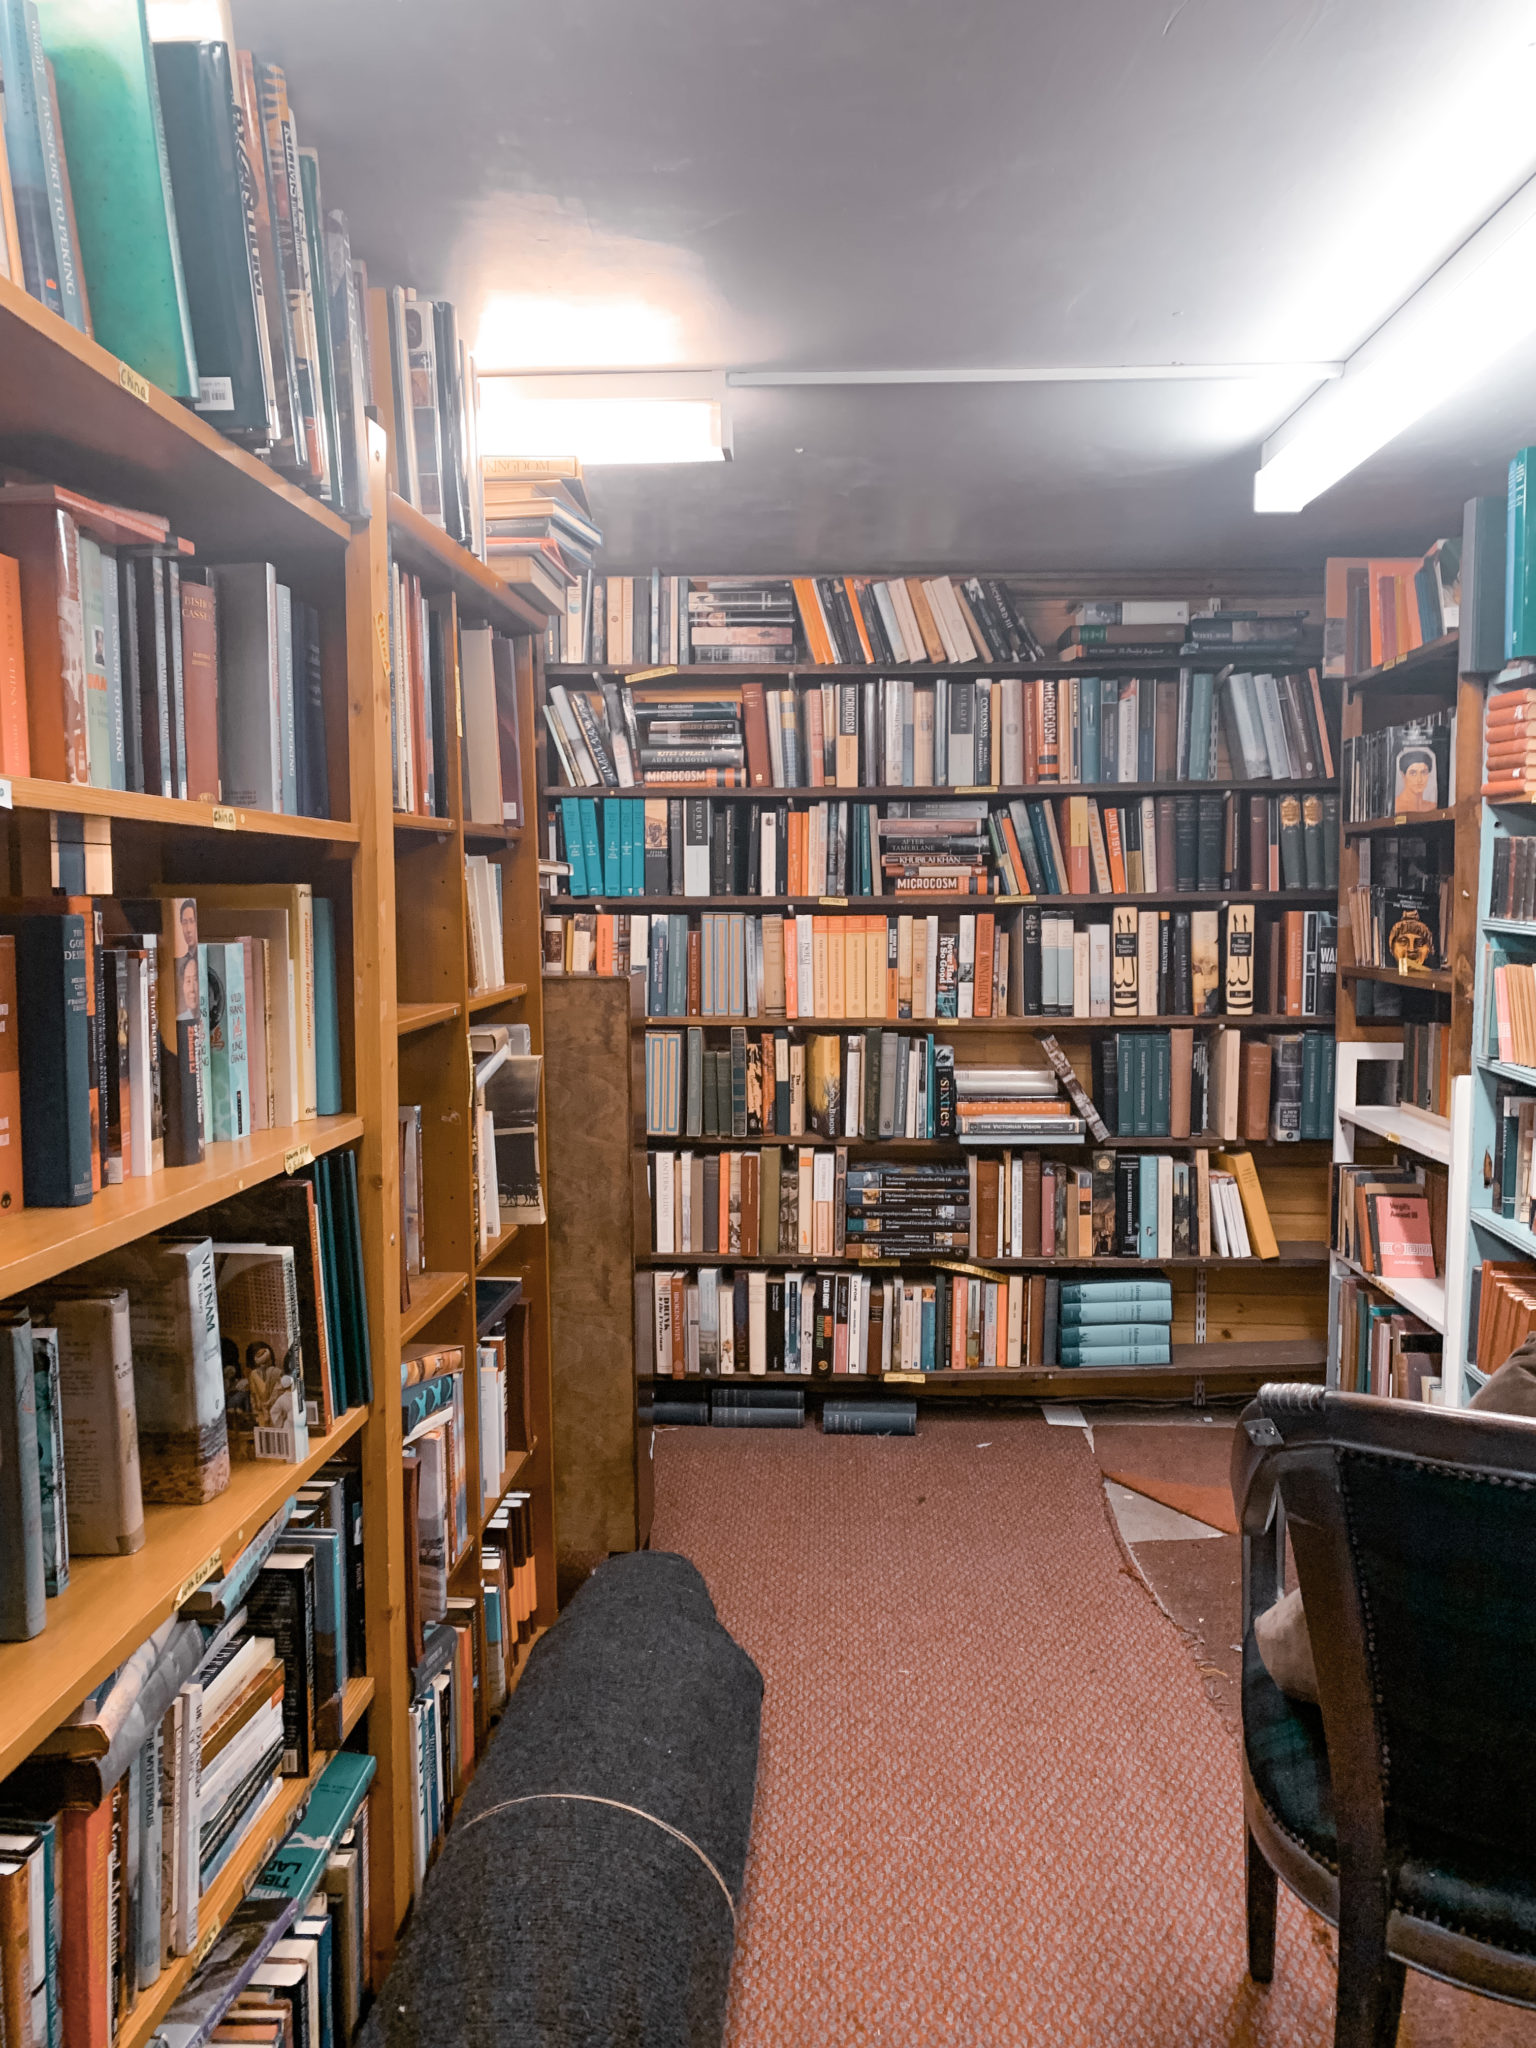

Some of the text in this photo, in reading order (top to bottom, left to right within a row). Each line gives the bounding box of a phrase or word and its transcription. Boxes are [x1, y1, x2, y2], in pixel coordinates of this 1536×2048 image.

[283, 124, 298, 198] KILIMS
[41, 96, 76, 298] PASSPORT TO PEKING
[121, 368, 149, 402] China
[485, 460, 550, 473] KINGDOM
[988, 580, 1009, 618] RICHARD
[7, 656, 17, 706] CHINA
[110, 613, 120, 677] PASSPORT
[115, 709, 124, 763] PEKING
[284, 647, 292, 705] PASSPORT
[845, 687, 856, 734] MICROCOSM
[980, 697, 989, 738] COLOSSUS
[1044, 681, 1056, 745] MICROCOSM
[287, 731, 296, 777] PEKING
[646, 770, 706, 782] MICROCOSM
[213, 811, 235, 824] China
[695, 800, 703, 841] EUROPE
[1107, 811, 1121, 857] JULY 1914
[892, 844, 936, 852] TAMERLANE
[902, 838, 925, 846] AFTER
[936, 856, 961, 864] KHAN
[896, 877, 958, 890] MICROCOSM
[939, 960, 947, 984] Good
[946, 937, 955, 984] Never Had
[151, 1023, 159, 1062] BLEEDS
[939, 1079, 952, 1127] sixties
[200, 1253, 216, 1334] VIETNAM
[144, 1754, 156, 1829] MYSTERIOUS
